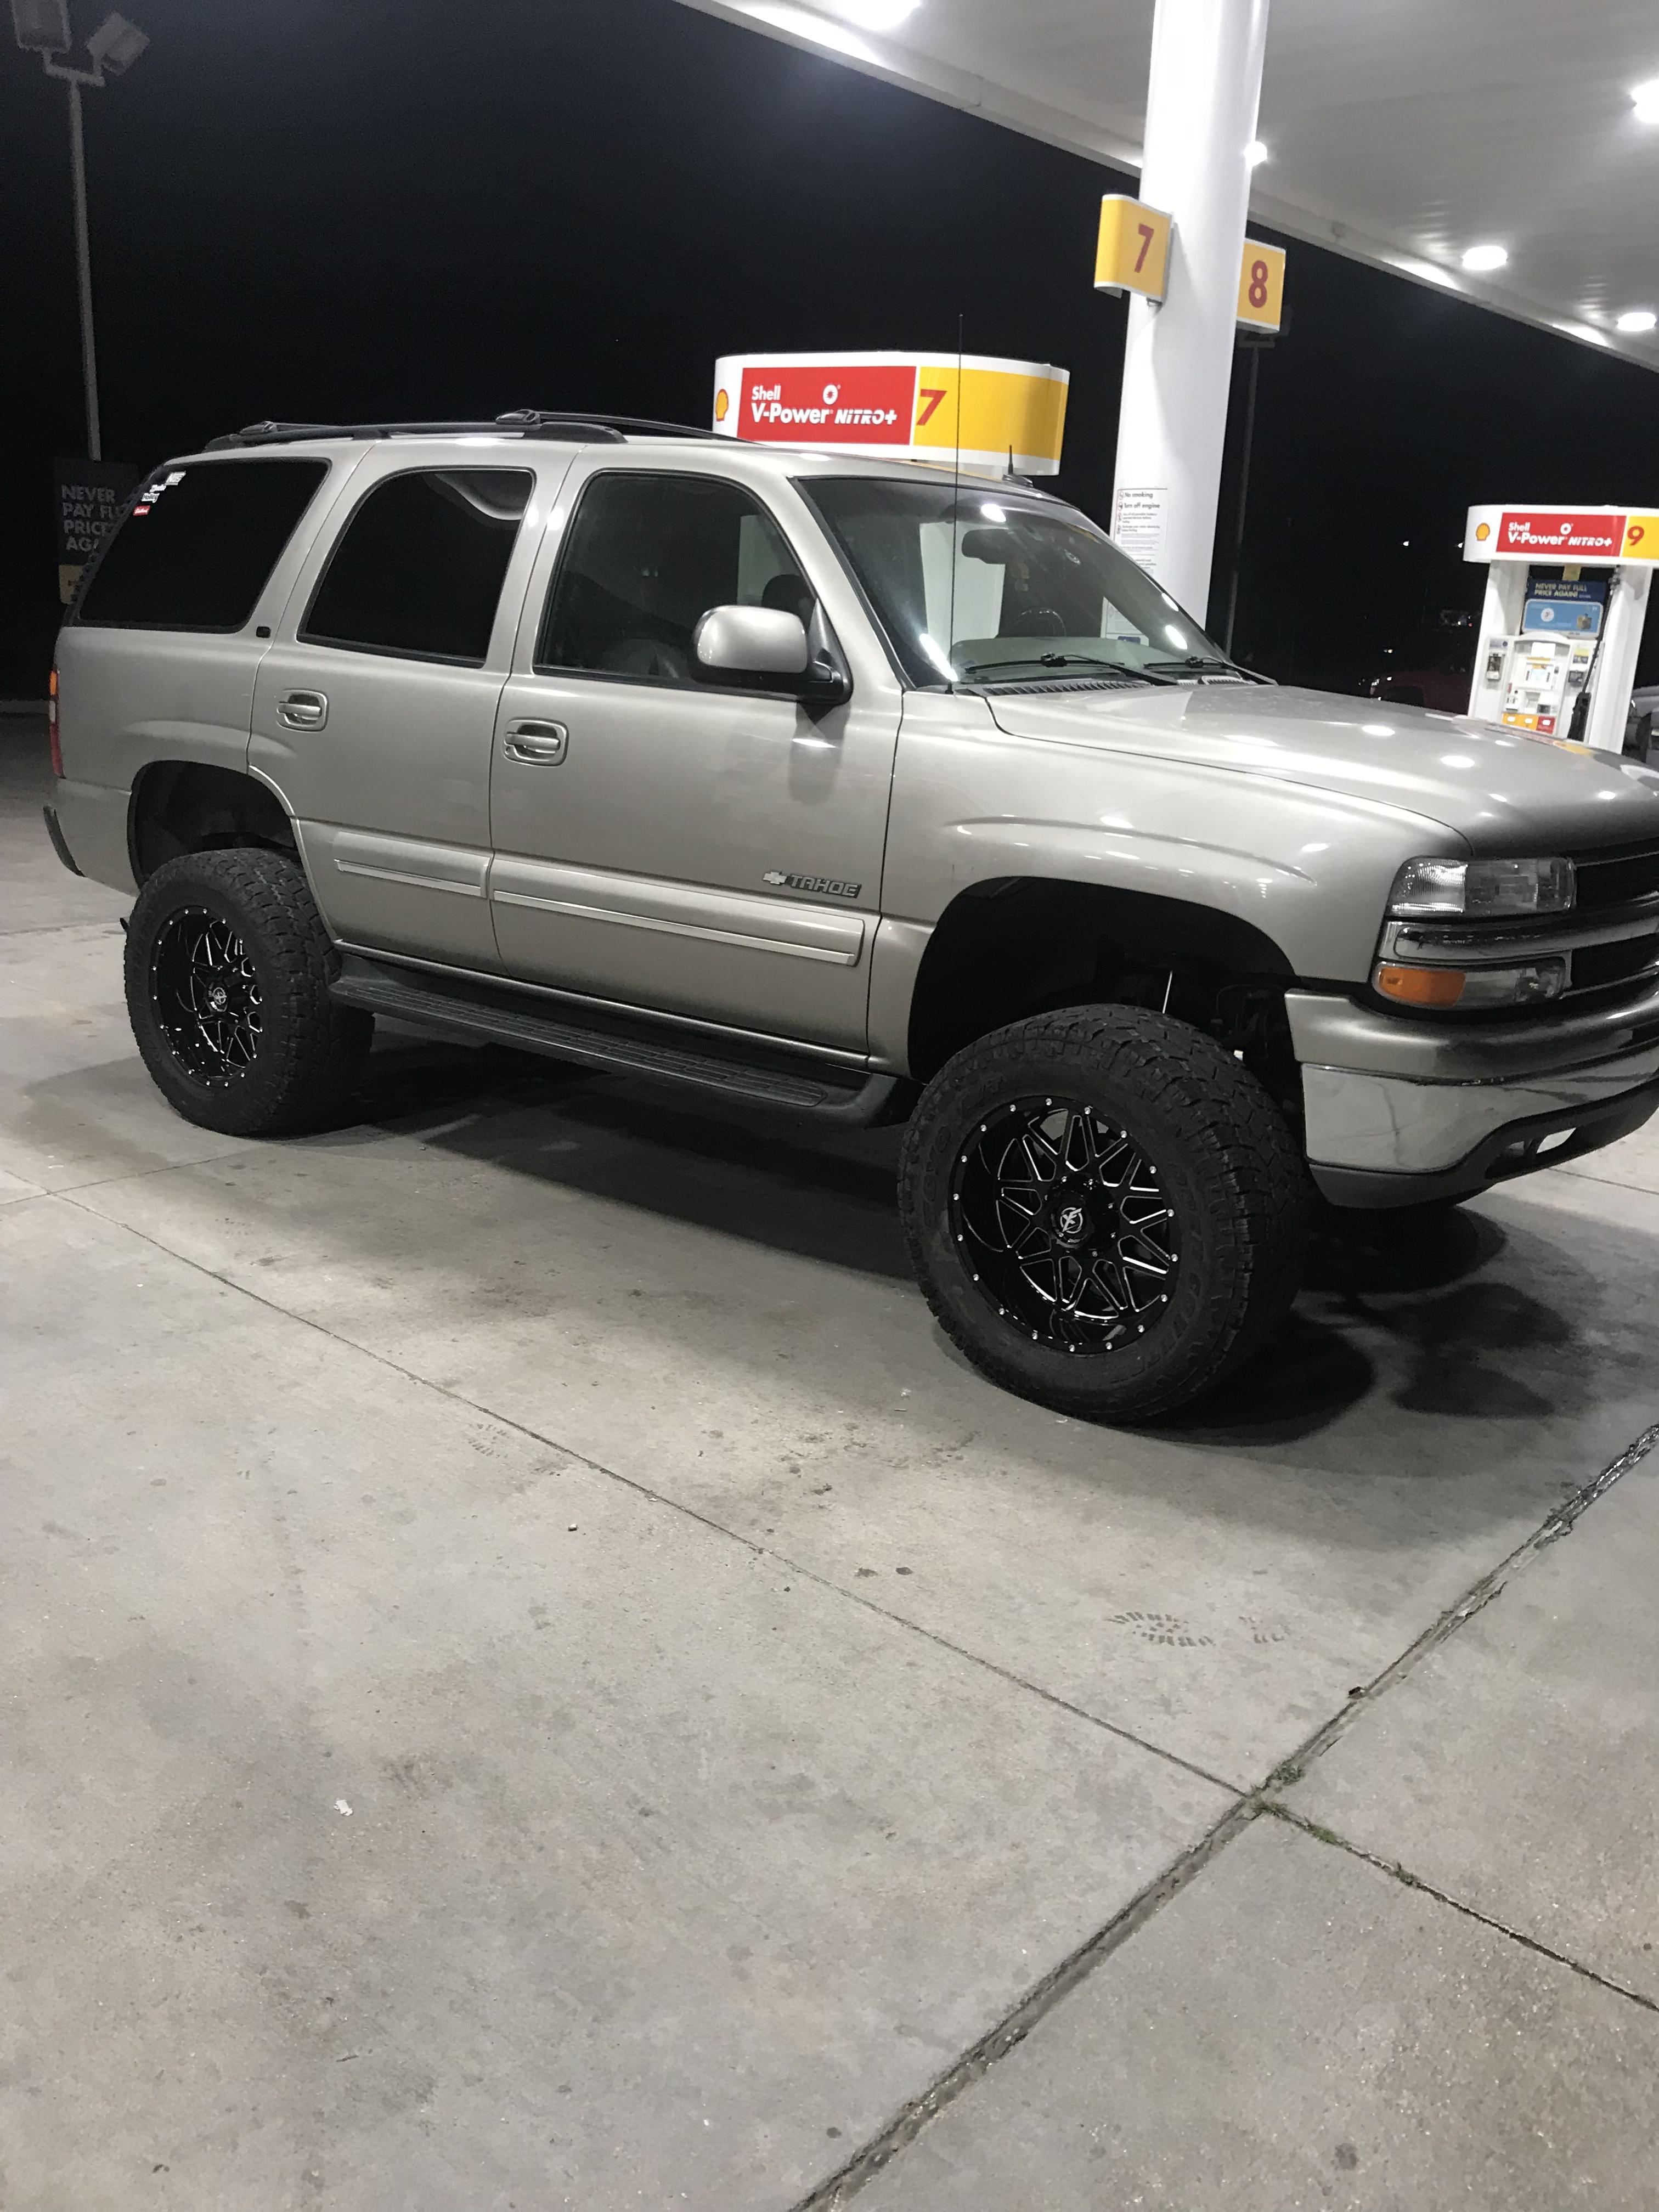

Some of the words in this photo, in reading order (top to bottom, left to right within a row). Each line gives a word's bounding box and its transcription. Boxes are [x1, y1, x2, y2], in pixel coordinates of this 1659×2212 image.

[1134, 223, 1154, 273] 7
[1248, 259, 1268, 308] 8
[751, 384, 781, 401] Shell
[751, 403, 831, 425] V-Power
[916, 389, 948, 426] 7
[61, 484, 115, 503] NEVER
[63, 502, 94, 518] PAY
[1508, 522, 1531, 532] Shell
[1627, 525, 1645, 546] 9
[1508, 532, 1564, 545] V-Power
[791, 874, 861, 898] TAHOE
